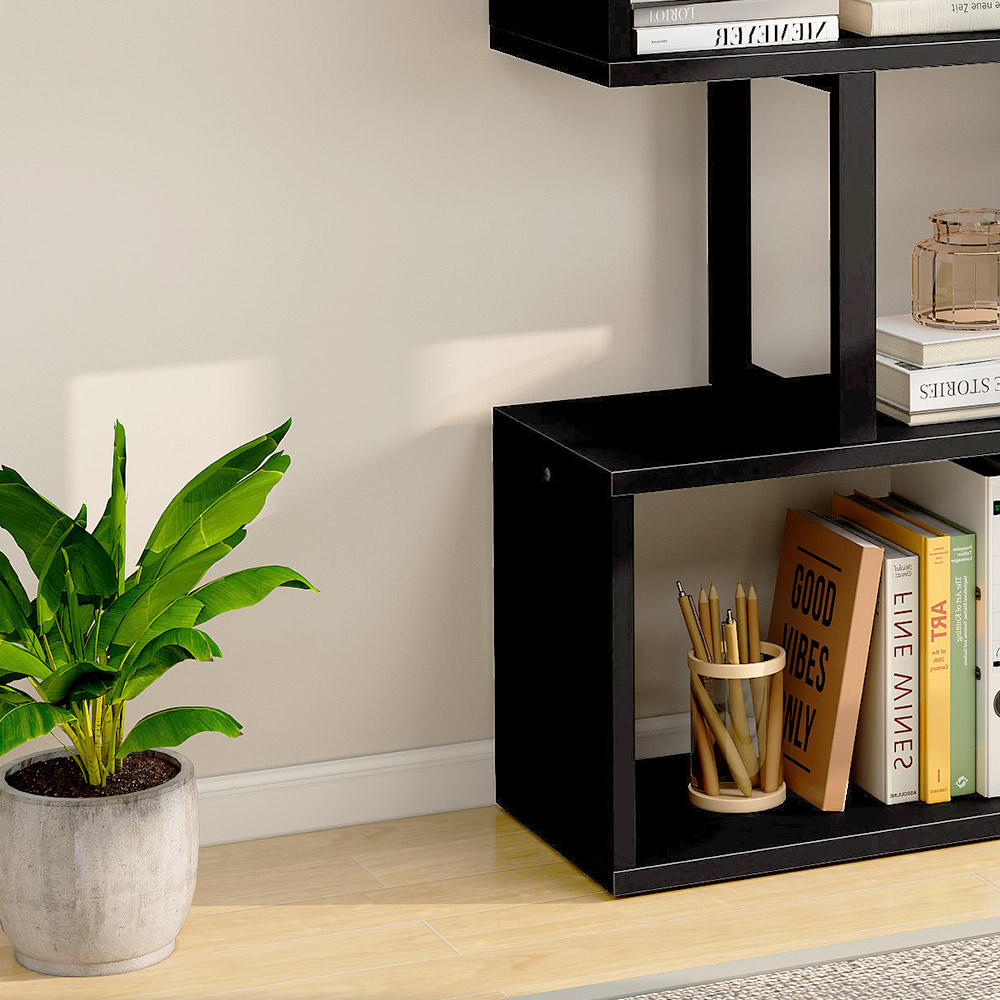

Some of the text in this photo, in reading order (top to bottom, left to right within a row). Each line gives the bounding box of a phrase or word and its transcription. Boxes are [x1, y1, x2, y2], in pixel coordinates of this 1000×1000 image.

[647, 6, 696, 23] LORIOT
[952, 3, 968, 13] Zeit
[971, 2, 992, 10] neue
[919, 377, 990, 400] STORIES
[791, 563, 837, 627] GOOD
[782, 622, 829, 693] VIBES
[782, 690, 817, 753] NLY
